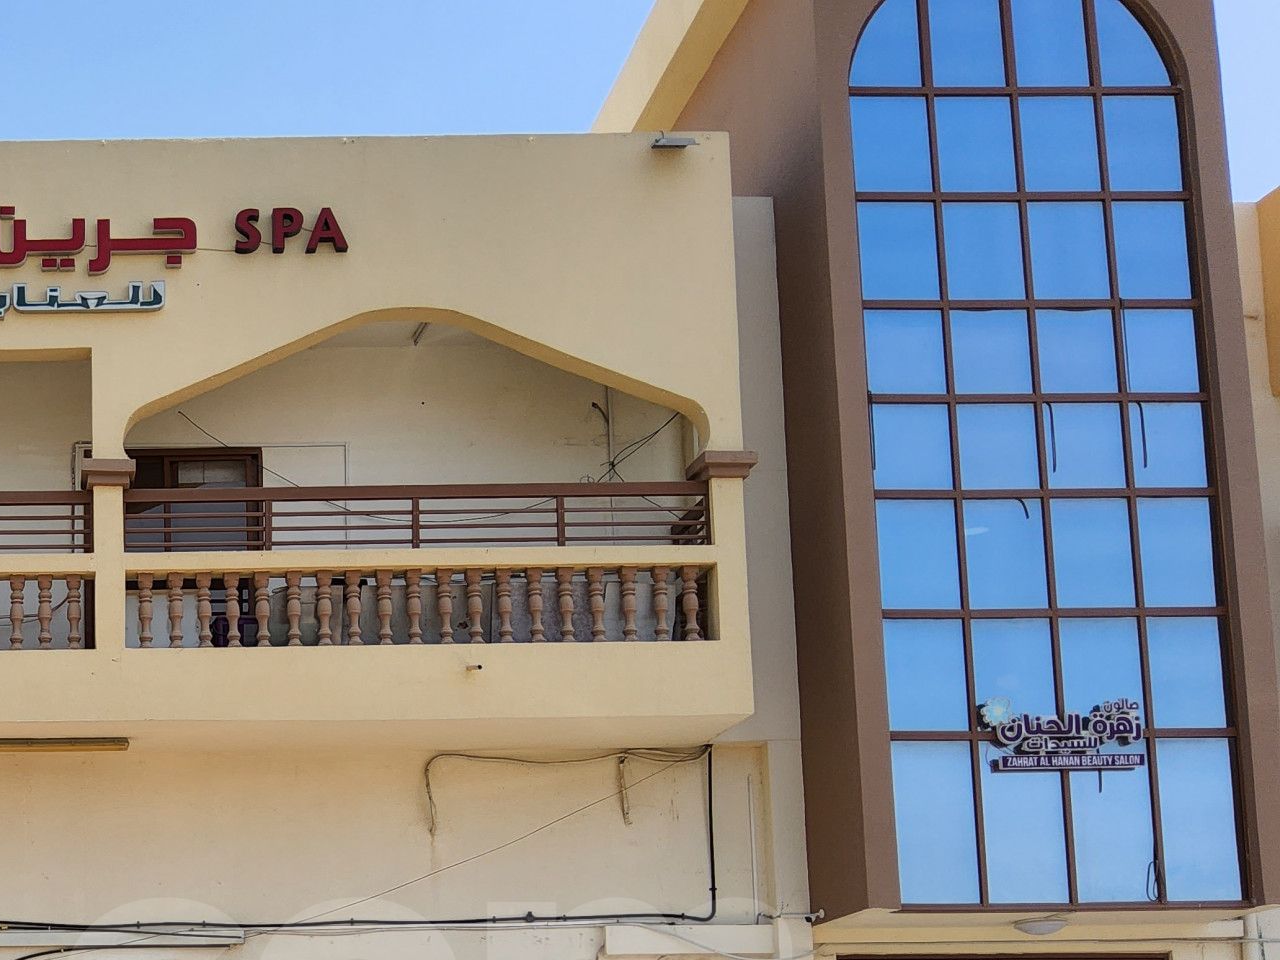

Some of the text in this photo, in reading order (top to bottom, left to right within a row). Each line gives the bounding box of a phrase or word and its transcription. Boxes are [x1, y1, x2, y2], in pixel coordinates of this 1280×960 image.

[233, 206, 349, 254] SPA
[1103, 698, 1139, 713] صالون
[1000, 712, 1142, 742] زهرة الحنان
[1026, 736, 1098, 753] للسيدات
[1007, 755, 1140, 767] ZAHRAT AL HANAN BEAUTY SALON
